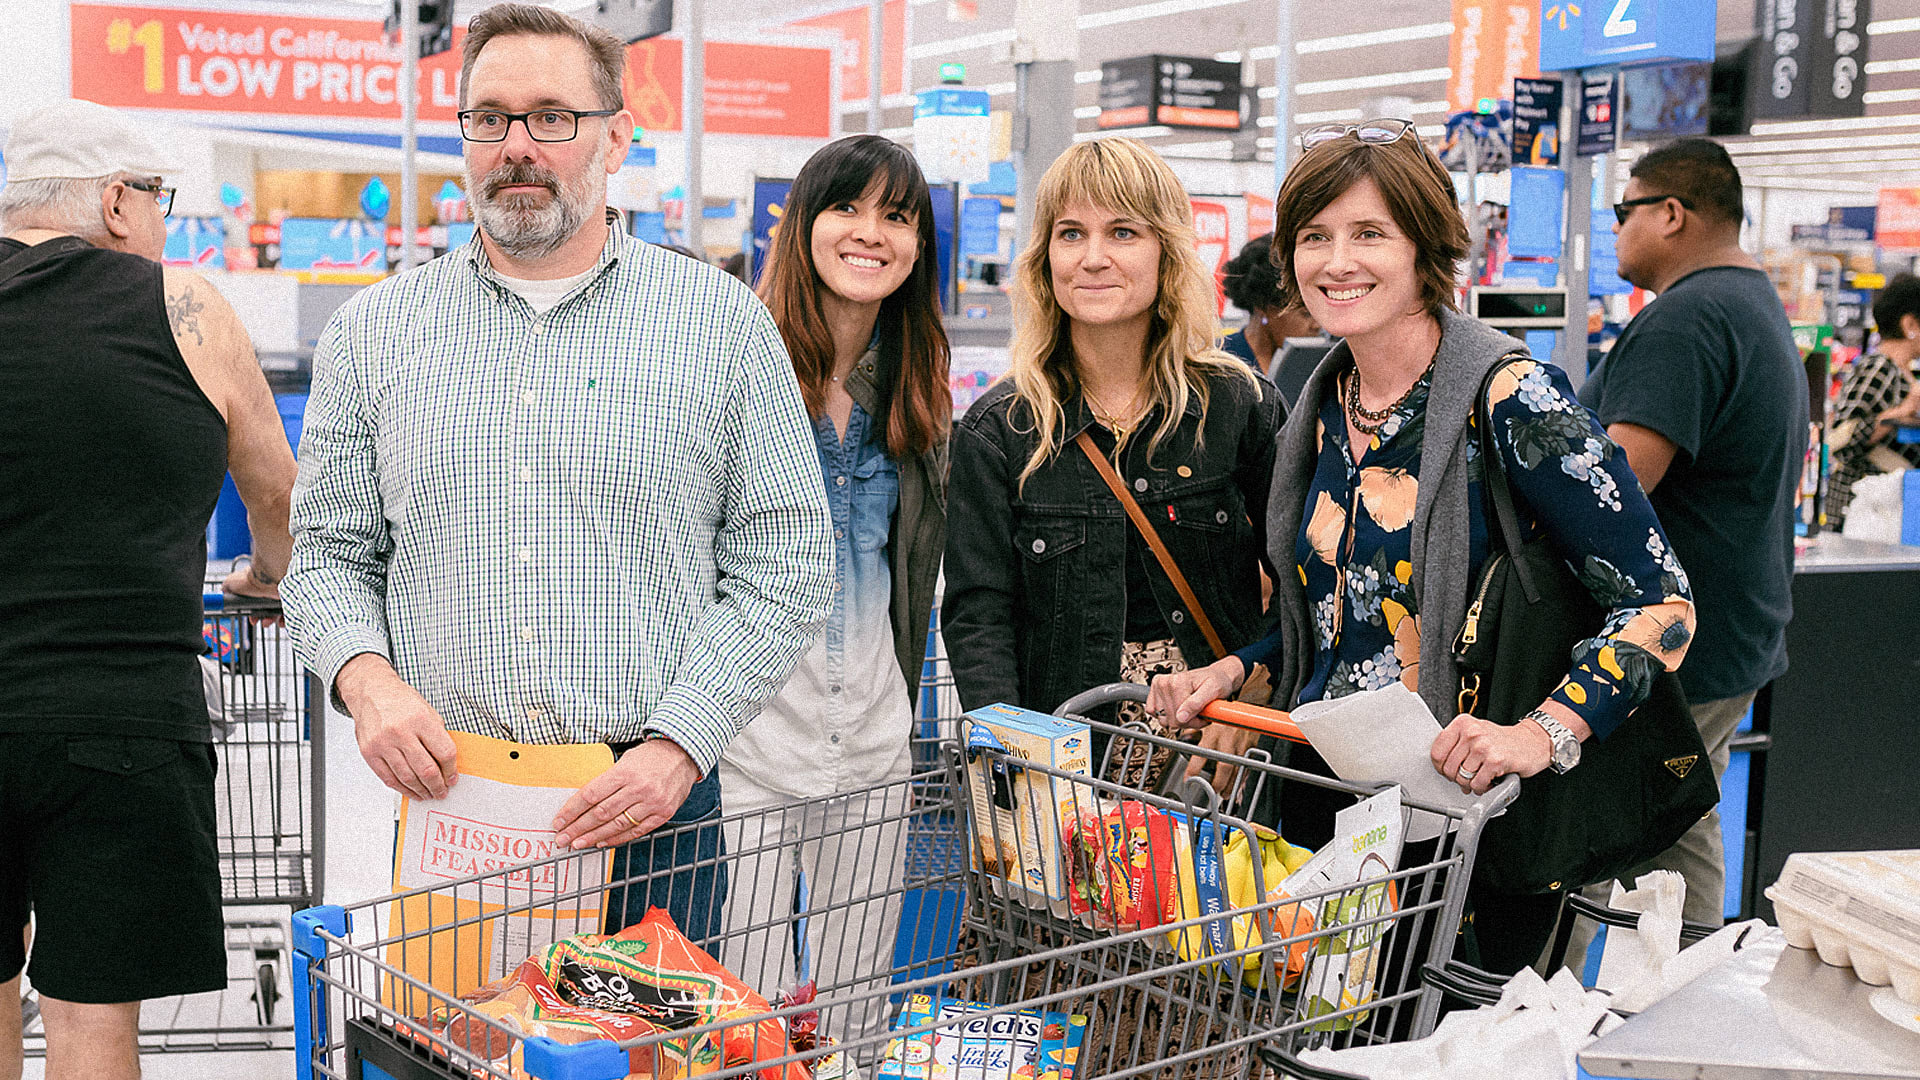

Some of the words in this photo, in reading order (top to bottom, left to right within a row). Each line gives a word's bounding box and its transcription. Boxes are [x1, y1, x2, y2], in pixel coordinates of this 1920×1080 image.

[107, 18, 164, 94] #1
[178, 21, 265, 56] Voted
[177, 54, 283, 99] LOW
[1772, 56, 1798, 99] Go
[1832, 56, 1858, 99] Go
[434, 820, 557, 861] MISSION
[1207, 898, 1223, 949] Wamart
[944, 1013, 1039, 1037] Welch's
